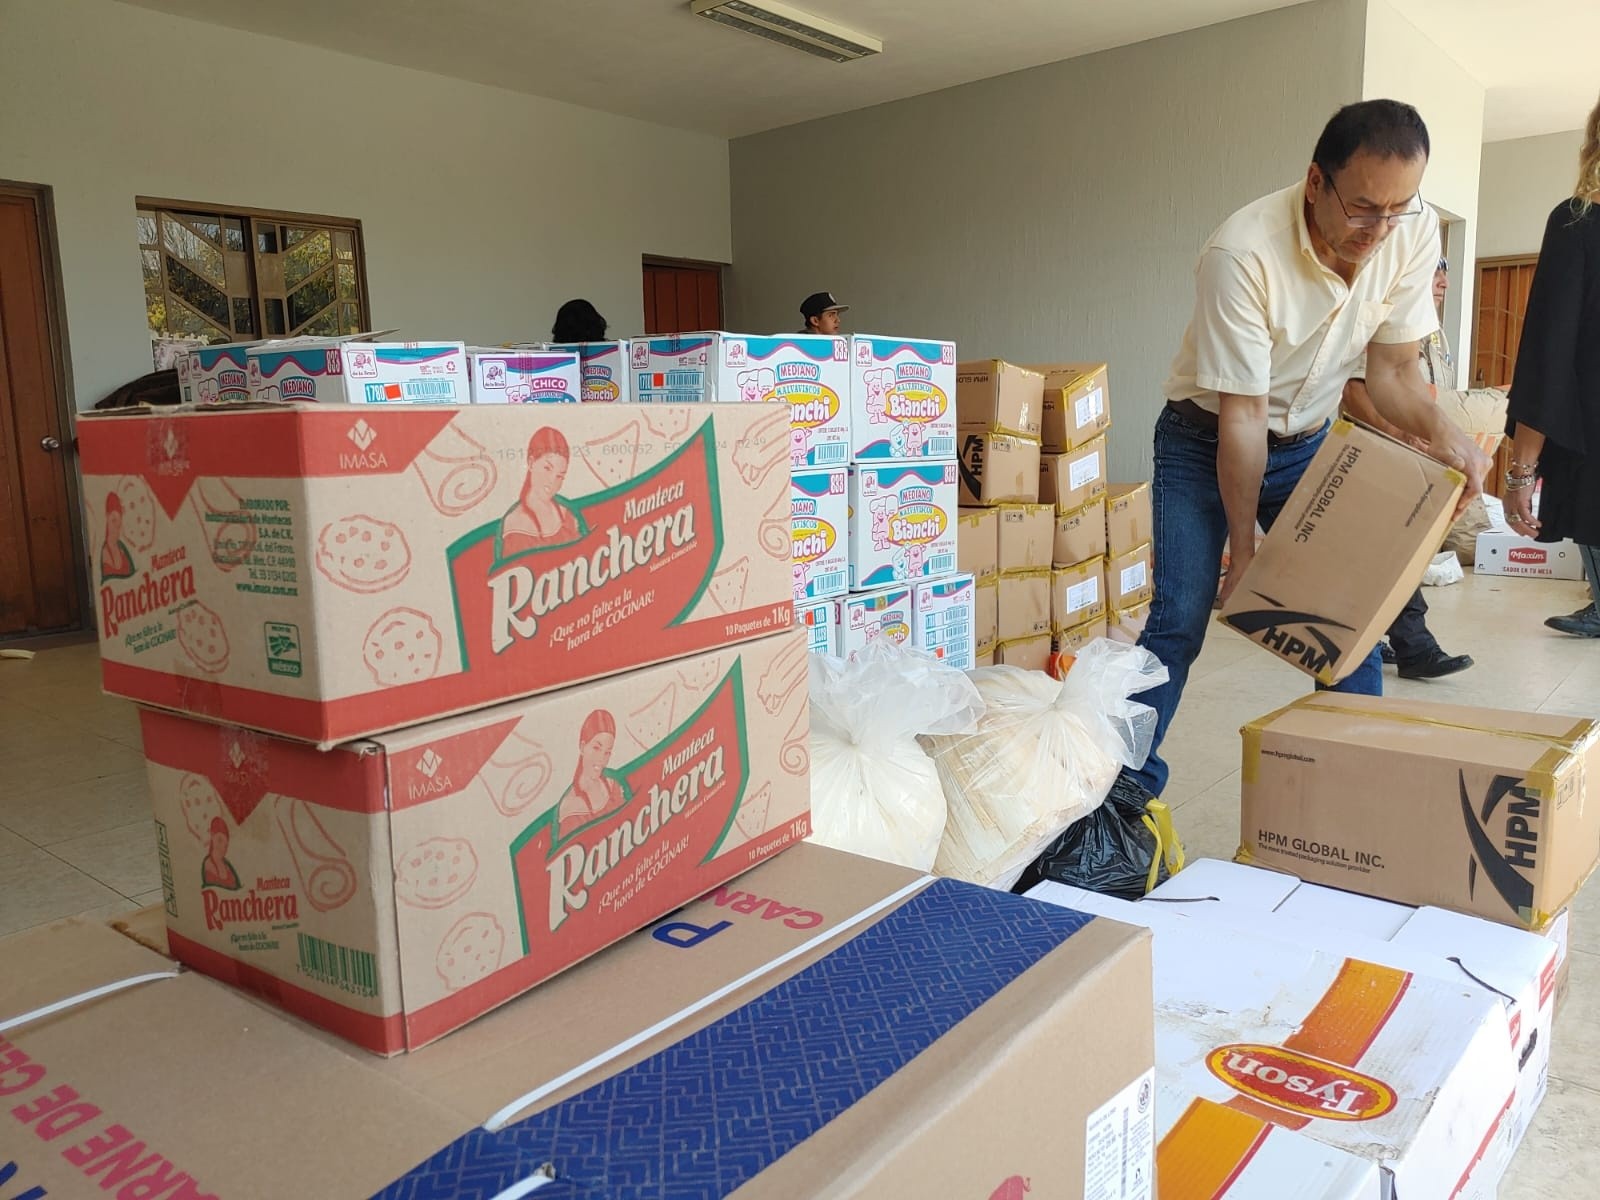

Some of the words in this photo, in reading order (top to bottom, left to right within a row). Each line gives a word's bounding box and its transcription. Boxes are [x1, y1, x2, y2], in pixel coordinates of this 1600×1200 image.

[533, 379, 566, 389] CHICO
[780, 366, 817, 378] MEDIANO
[899, 366, 929, 378] MEDIANO
[282, 380, 314, 395] MEDIANO
[581, 387, 614, 401] Bianchi
[776, 384, 821, 396] MALVAVISCOS
[889, 394, 940, 417] Bianchi
[338, 452, 389, 469] IMASA
[971, 438, 984, 477] HPM
[1337, 446, 1362, 475] HPM
[623, 480, 684, 524] Manteca
[791, 502, 814, 514] DIANO
[902, 489, 931, 502] MEDIANO
[1309, 475, 1344, 519] GLOBAL
[791, 519, 817, 530] AVISCOS
[891, 515, 940, 541] Bianchi
[1294, 521, 1316, 544] INC.
[151, 546, 186, 571] Manteca
[792, 530, 827, 558] nchi
[1510, 550, 1545, 560] Maxim
[487, 504, 696, 655] Ranchera
[101, 566, 197, 640] Ranchera
[549, 624, 576, 648] ¡Que
[577, 614, 590, 629] no
[591, 599, 615, 625] falte
[623, 588, 633, 603] la
[567, 631, 591, 651] hora
[592, 620, 604, 635] de
[605, 590, 656, 629] COCINAR!
[725, 625, 734, 636] 10
[734, 621, 763, 635] Paquetes
[763, 616, 771, 627] de
[772, 606, 791, 627] 1Kg
[1261, 625, 1326, 674] HPM
[662, 727, 715, 780] Manteca
[408, 775, 453, 800] IMASA
[546, 745, 725, 931] Ranchera
[748, 850, 756, 861] 10
[756, 838, 783, 859] Paquetes
[783, 833, 790, 844] de
[789, 819, 808, 841] 1Kg
[1504, 786, 1542, 869] HPM
[1258, 829, 1288, 847] HPM
[1291, 838, 1350, 862] GLOBAL
[1354, 851, 1385, 869] INC.
[1267, 845, 1280, 853] most
[1280, 848, 1299, 859] trusted
[1298, 852, 1326, 865] packaging
[1325, 859, 1347, 868] solution
[1347, 863, 1371, 874] provider
[256, 875, 291, 892] Manteca
[598, 883, 621, 914] ¡Que
[621, 873, 635, 890] no
[634, 853, 654, 881] falte
[661, 838, 670, 852] la
[613, 890, 635, 913] hora
[634, 877, 646, 893] de
[646, 834, 691, 884] COCINAR!
[202, 889, 299, 932] Ranchera
[702, 887, 824, 930] CARN
[1226, 1051, 1364, 1116] Tyson
[11, 1084, 103, 1142] DE
